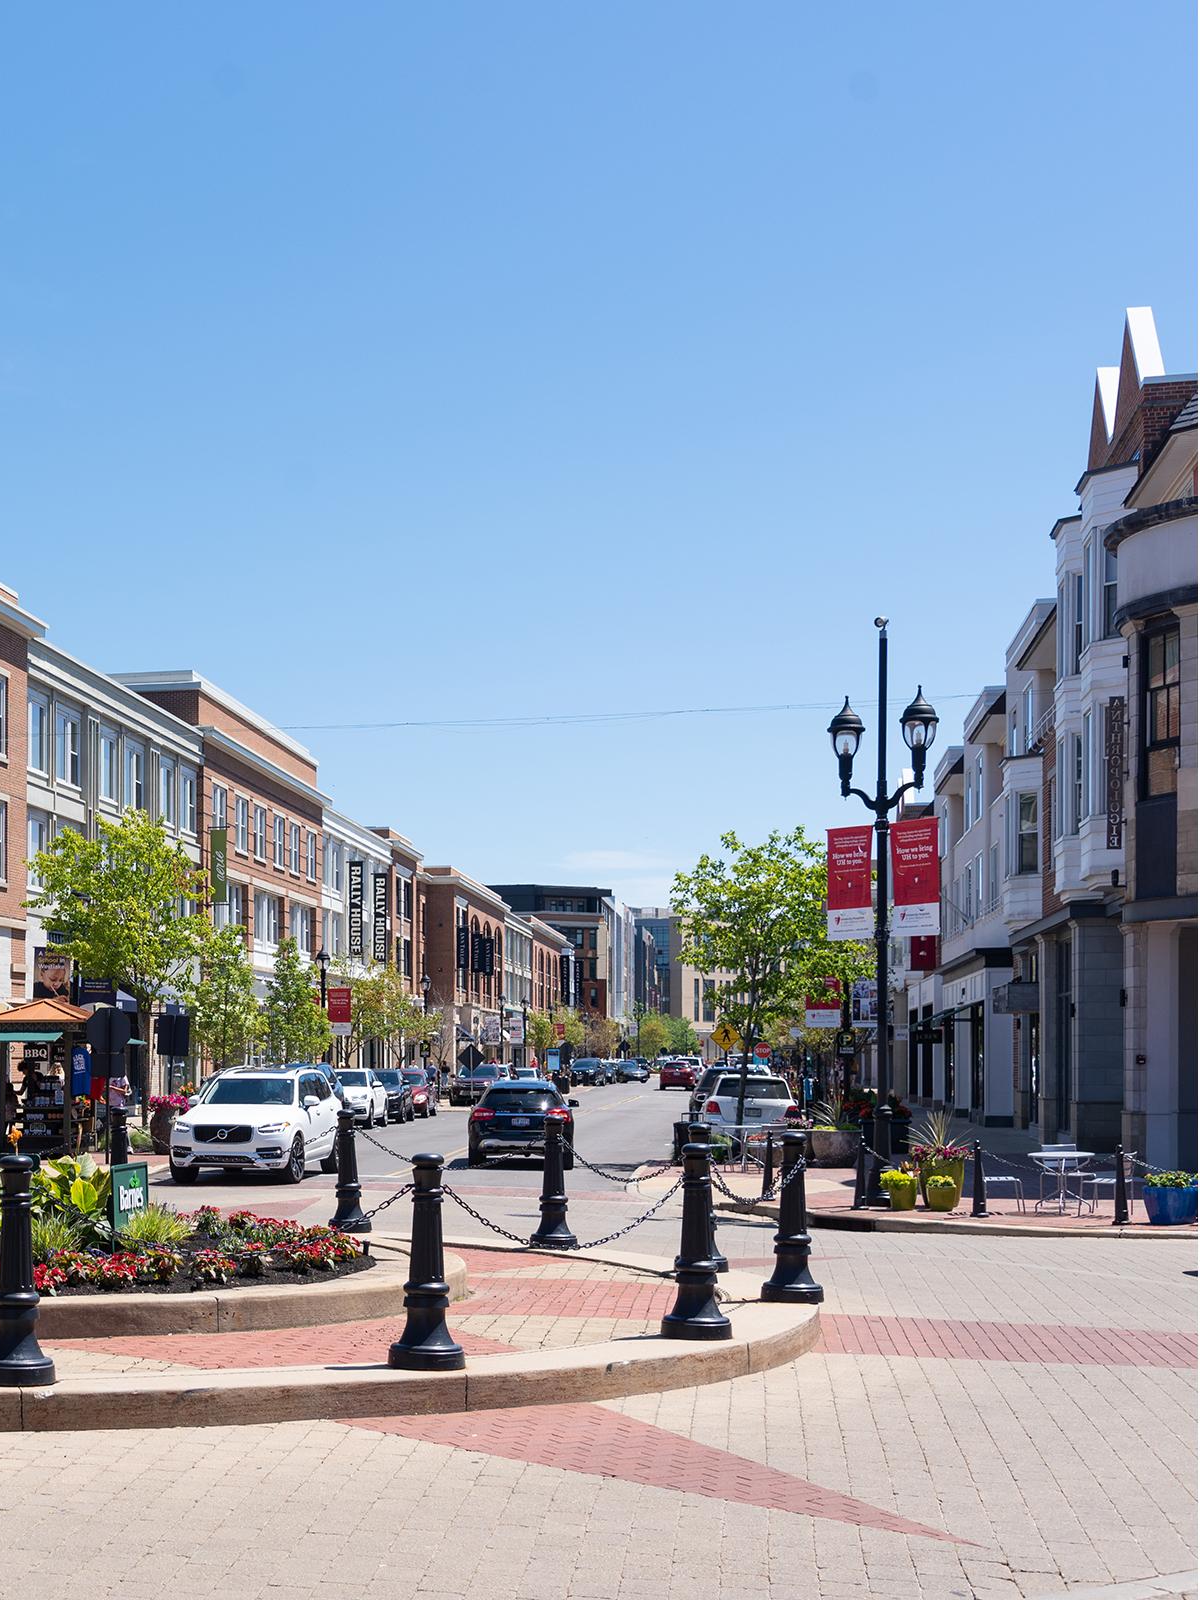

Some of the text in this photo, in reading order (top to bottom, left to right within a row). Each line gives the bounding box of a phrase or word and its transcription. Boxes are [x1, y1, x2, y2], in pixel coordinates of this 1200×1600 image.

[853, 850, 868, 859] bring
[896, 847, 910, 855] How
[918, 844, 933, 853] bring
[213, 850, 225, 881] aerie
[350, 866, 362, 956] RALLY HOUSE
[375, 878, 386, 959] RALLY HOUSE
[24, 1048, 48, 1058] BBQ
[119, 1185, 144, 1211] Barnes
